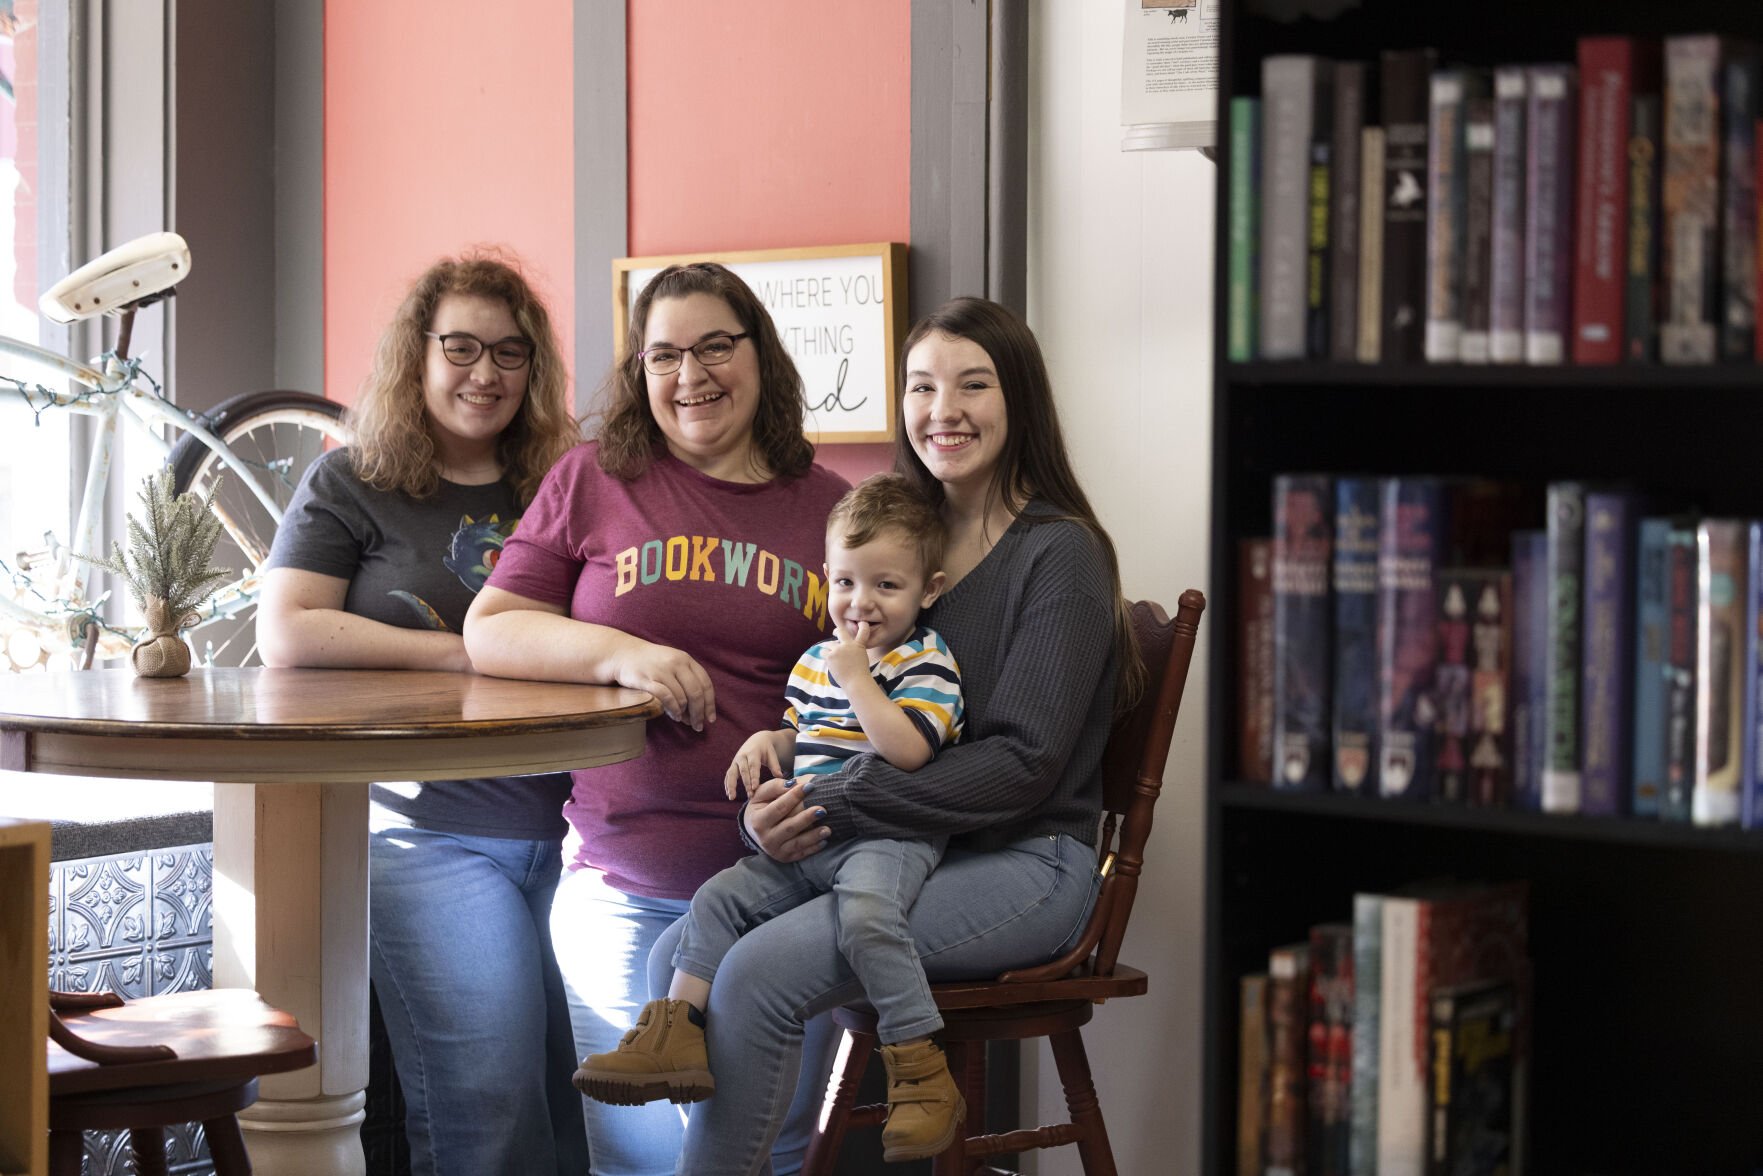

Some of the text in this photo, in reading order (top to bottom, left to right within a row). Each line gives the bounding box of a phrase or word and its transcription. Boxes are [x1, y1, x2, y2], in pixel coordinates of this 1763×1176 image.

[758, 275, 884, 309] WHERE YOU
[615, 535, 829, 632] BOOKWORM
